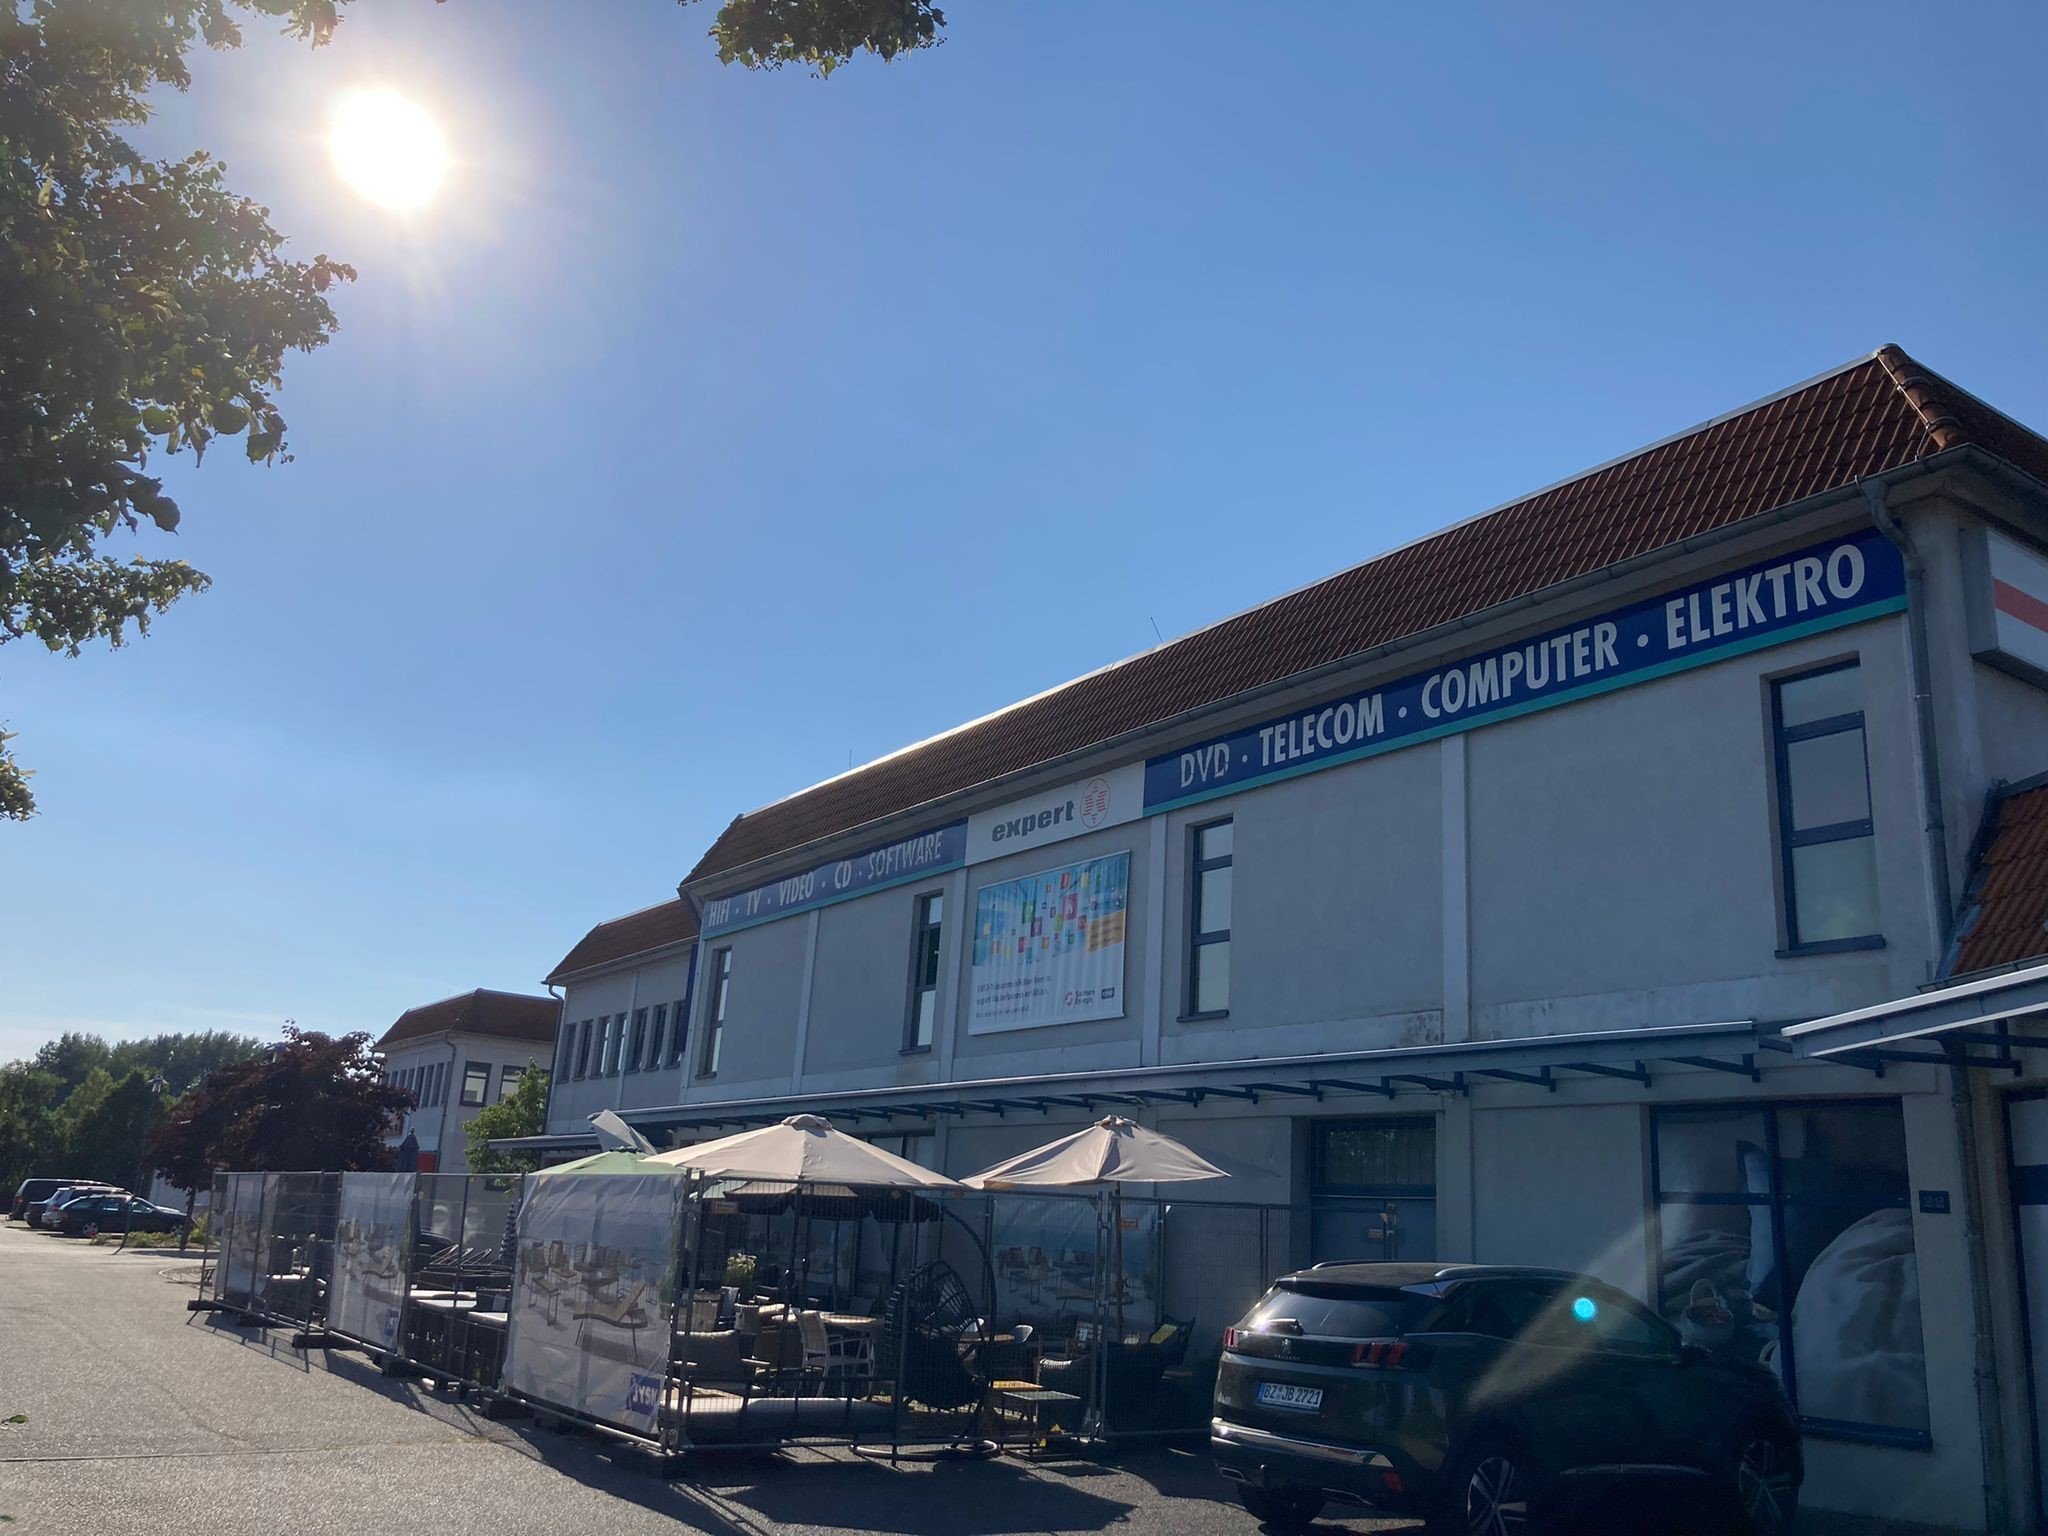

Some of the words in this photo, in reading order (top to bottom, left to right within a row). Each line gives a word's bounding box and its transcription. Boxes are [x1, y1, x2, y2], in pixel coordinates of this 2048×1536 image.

[1180, 743, 1230, 789] DVD
[1258, 693, 1384, 766] TELECOM
[1421, 621, 1619, 719] COMPUTER
[1666, 543, 1866, 650] ELEKTRO
[992, 800, 1075, 842] expert
[746, 889, 762, 916] TV
[779, 872, 814, 906] VIDEO
[834, 860, 852, 889] CD
[868, 830, 944, 880] SOFTWARE
[632, 1385, 658, 1406] JYSK
[1295, 1389, 1321, 1405] 2721
